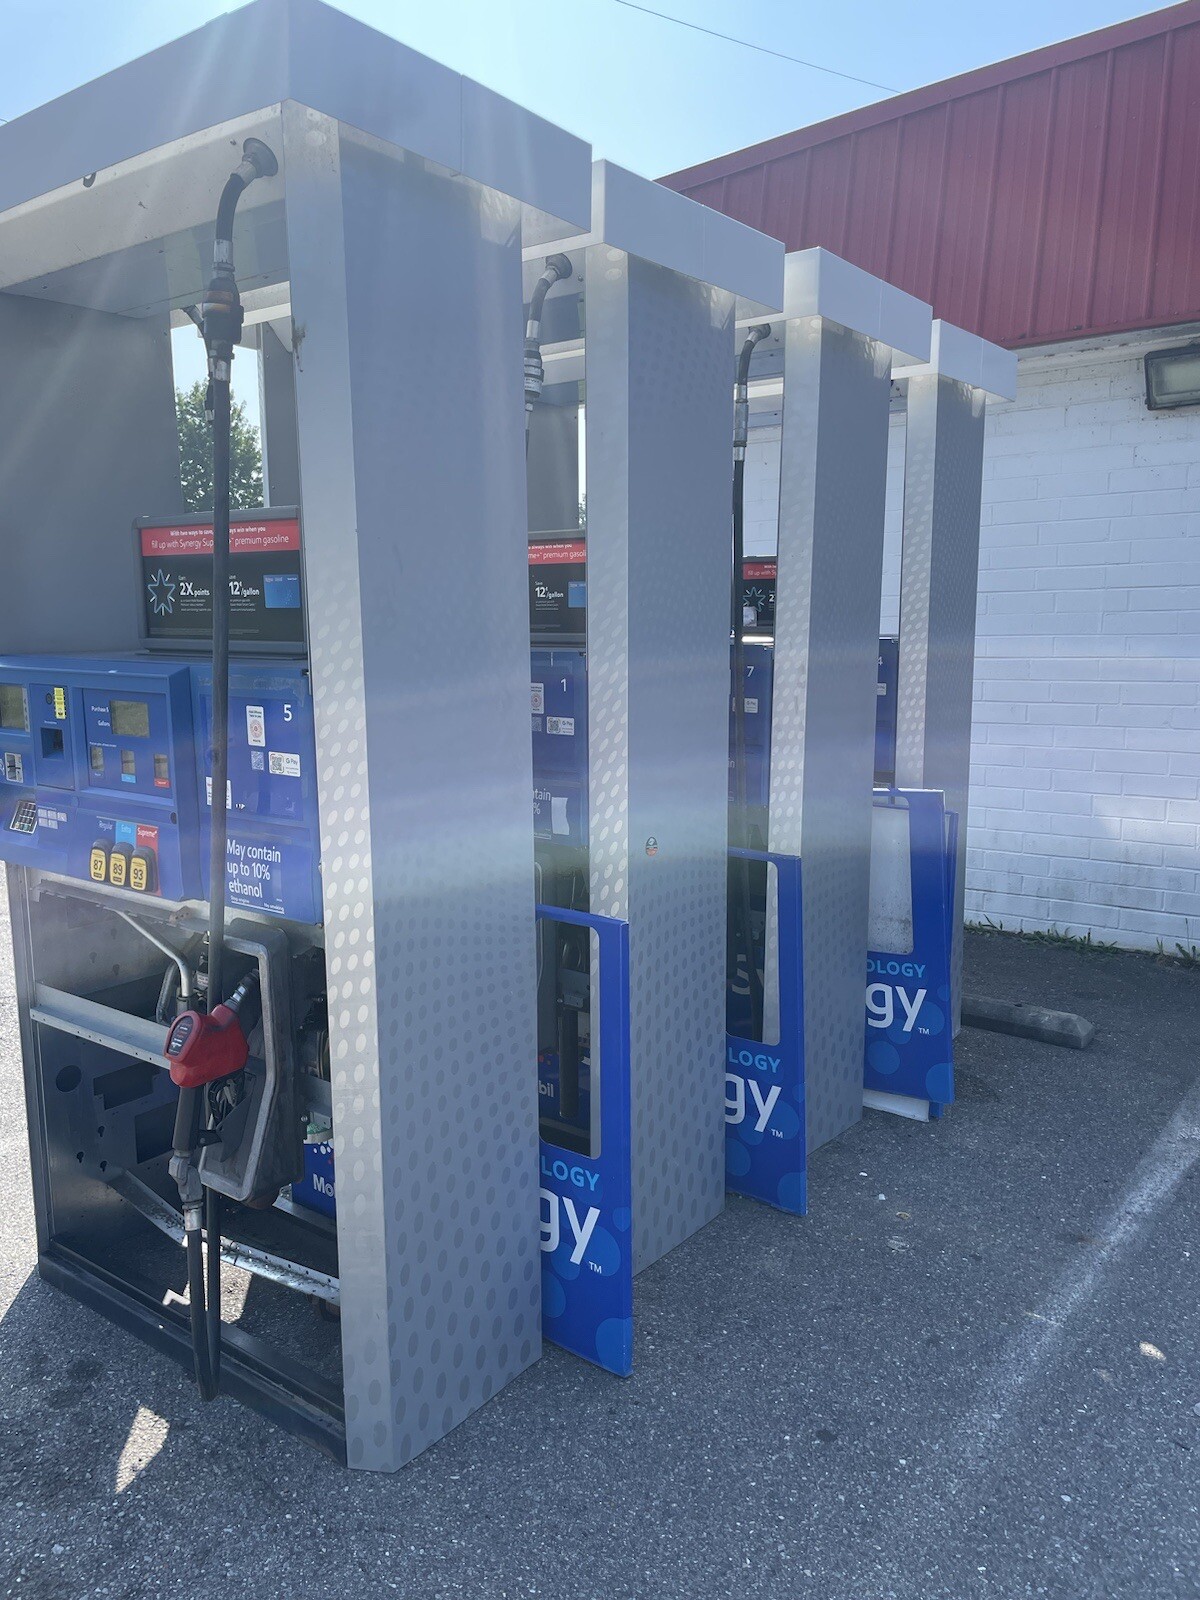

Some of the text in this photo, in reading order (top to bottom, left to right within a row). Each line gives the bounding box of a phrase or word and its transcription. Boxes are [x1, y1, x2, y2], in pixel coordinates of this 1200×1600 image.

[158, 541, 166, 550] up
[167, 540, 179, 548] with
[180, 539, 201, 549] Synergy
[234, 536, 262, 547] premium
[262, 534, 290, 546] gasoline
[543, 552, 568, 560] premium
[180, 582, 210, 598] 2X points
[746, 666, 754, 677] 7
[560, 678, 566, 692] 1
[284, 704, 292, 722] 5
[226, 839, 280, 863] May contain
[94, 860, 102, 871] 87
[114, 864, 122, 876] 89
[134, 868, 144, 880] 93
[227, 862, 270, 880] up to 10%
[228, 878, 262, 898] ethanol
[866, 982, 927, 1032] gy
[728, 1046, 780, 1073] LOGY
[541, 1156, 600, 1192] LOGY
[313, 1173, 334, 1198] Mo
